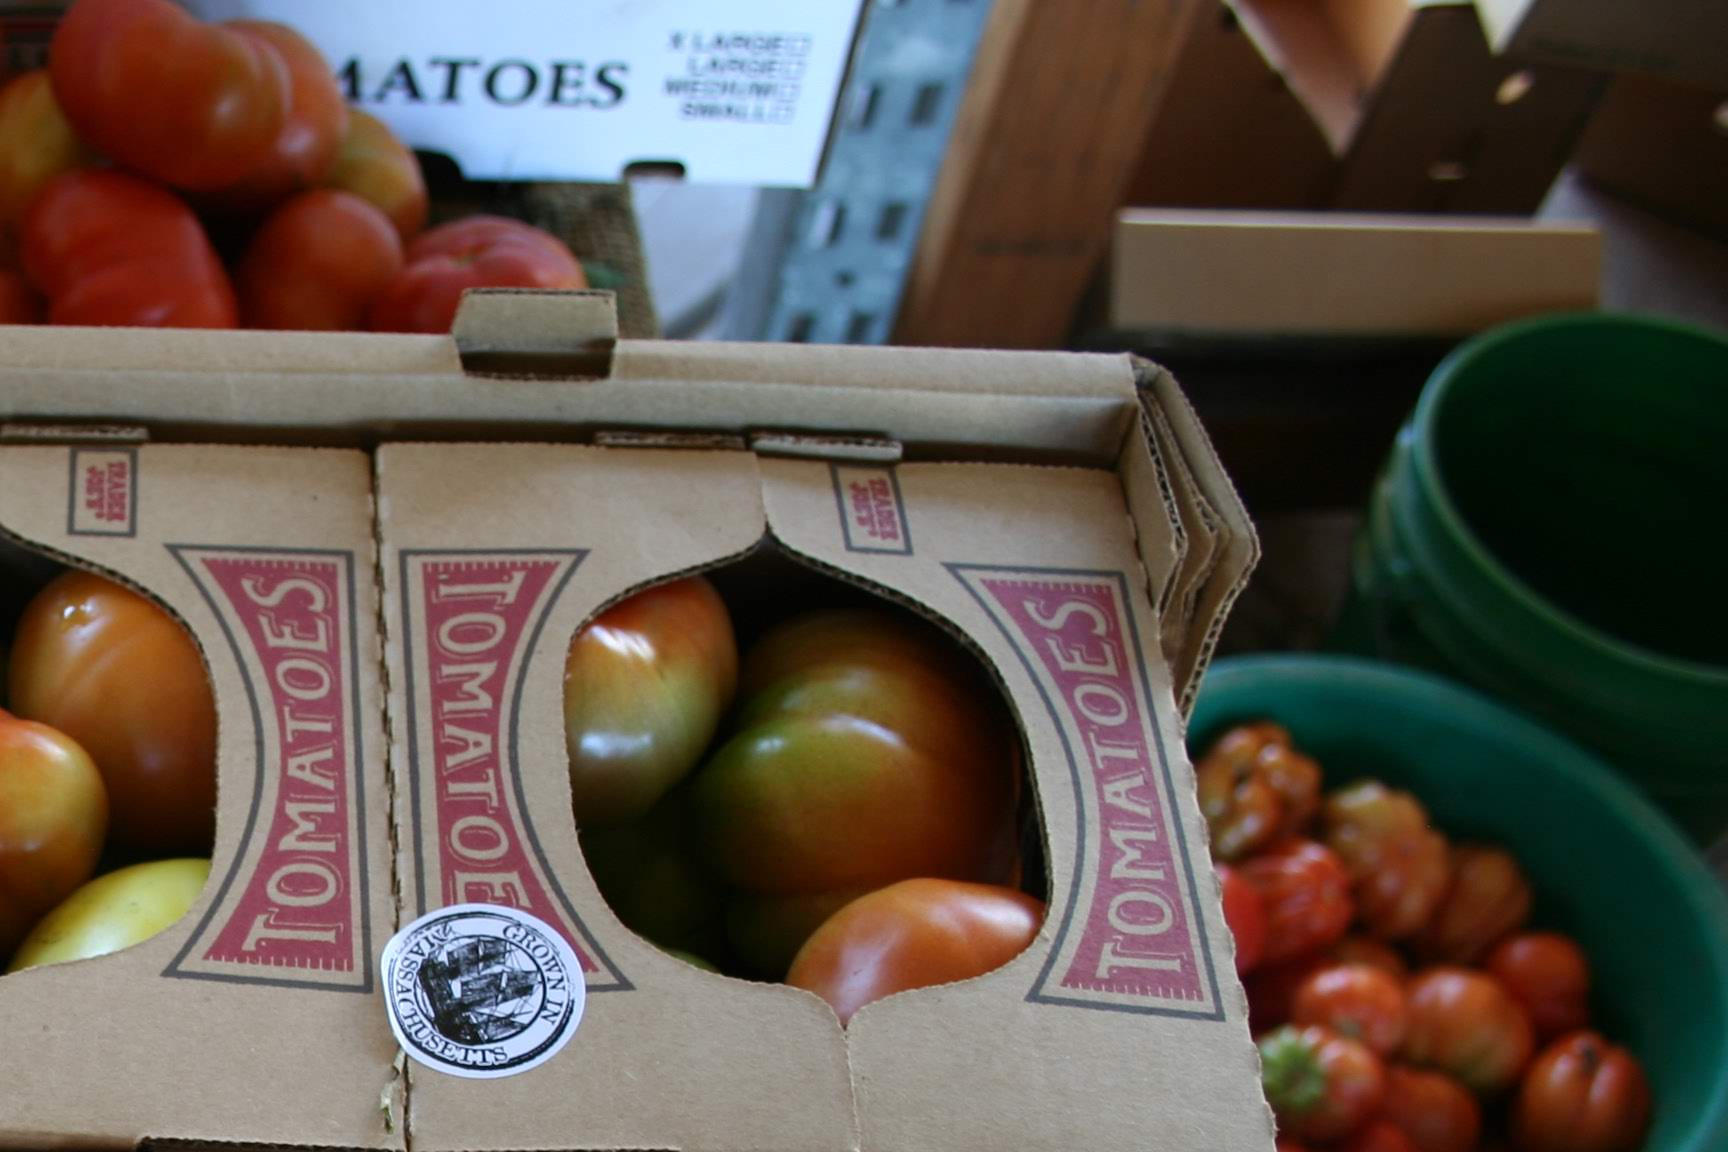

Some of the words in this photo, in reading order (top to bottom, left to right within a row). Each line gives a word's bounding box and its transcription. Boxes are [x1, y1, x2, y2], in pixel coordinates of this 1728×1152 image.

[242, 573, 344, 952] TOMATOES
[433, 570, 532, 908] TOMATOE
[1025, 598, 1185, 980] TOMATOES
[396, 923, 508, 1064] MASSACHUSETTS
[503, 924, 565, 992] GROWN
[541, 999, 563, 1026] IN
